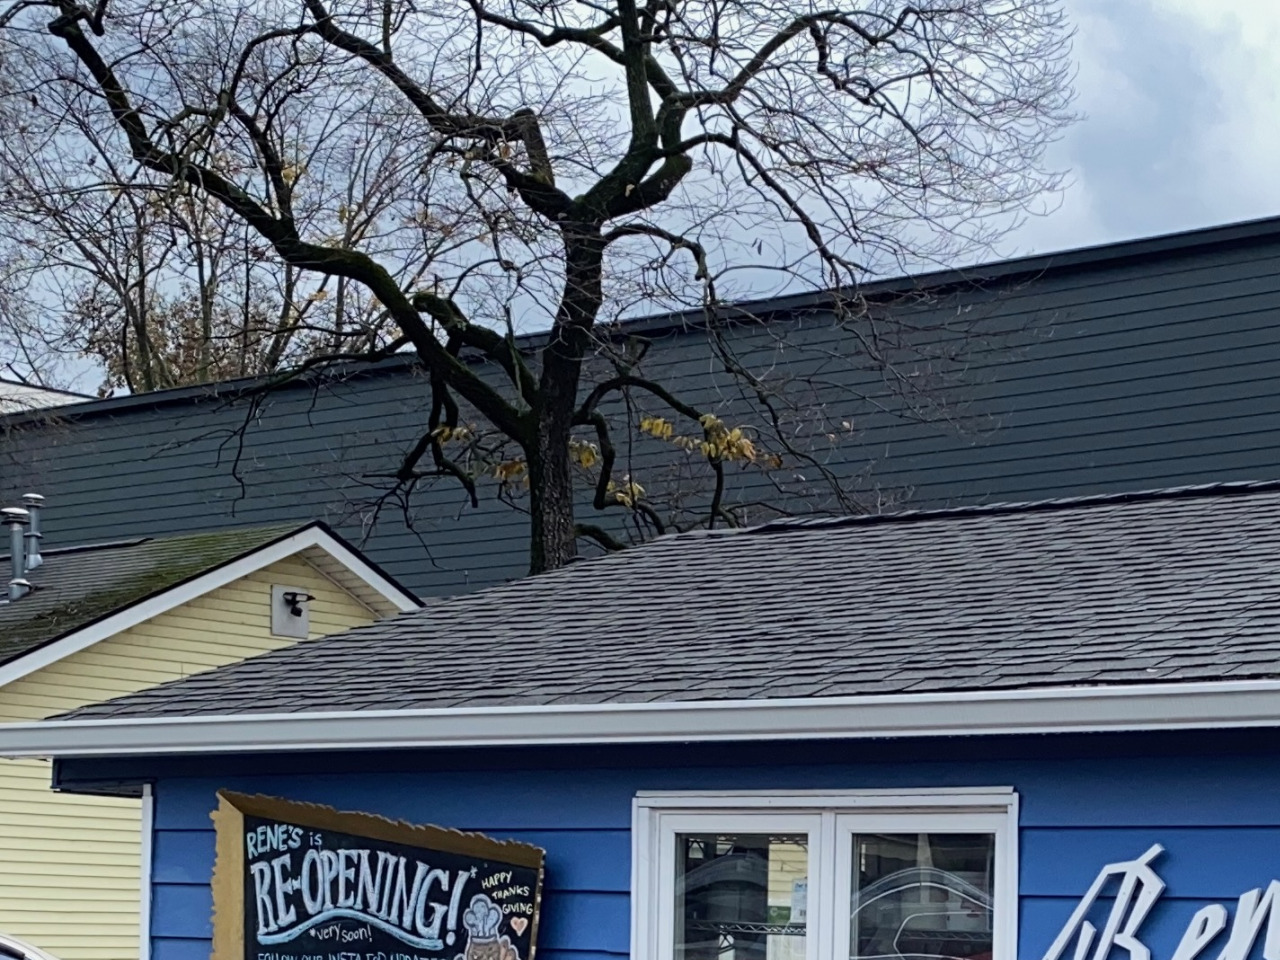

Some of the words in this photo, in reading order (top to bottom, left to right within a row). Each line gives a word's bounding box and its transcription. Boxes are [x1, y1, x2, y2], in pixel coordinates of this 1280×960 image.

[246, 823, 304, 860] RENE'S
[309, 831, 323, 846] is
[482, 871, 513, 889] HAPPY
[491, 885, 530, 900] THANKS
[502, 902, 534, 915] GIVING
[341, 925, 373, 943] soon!
